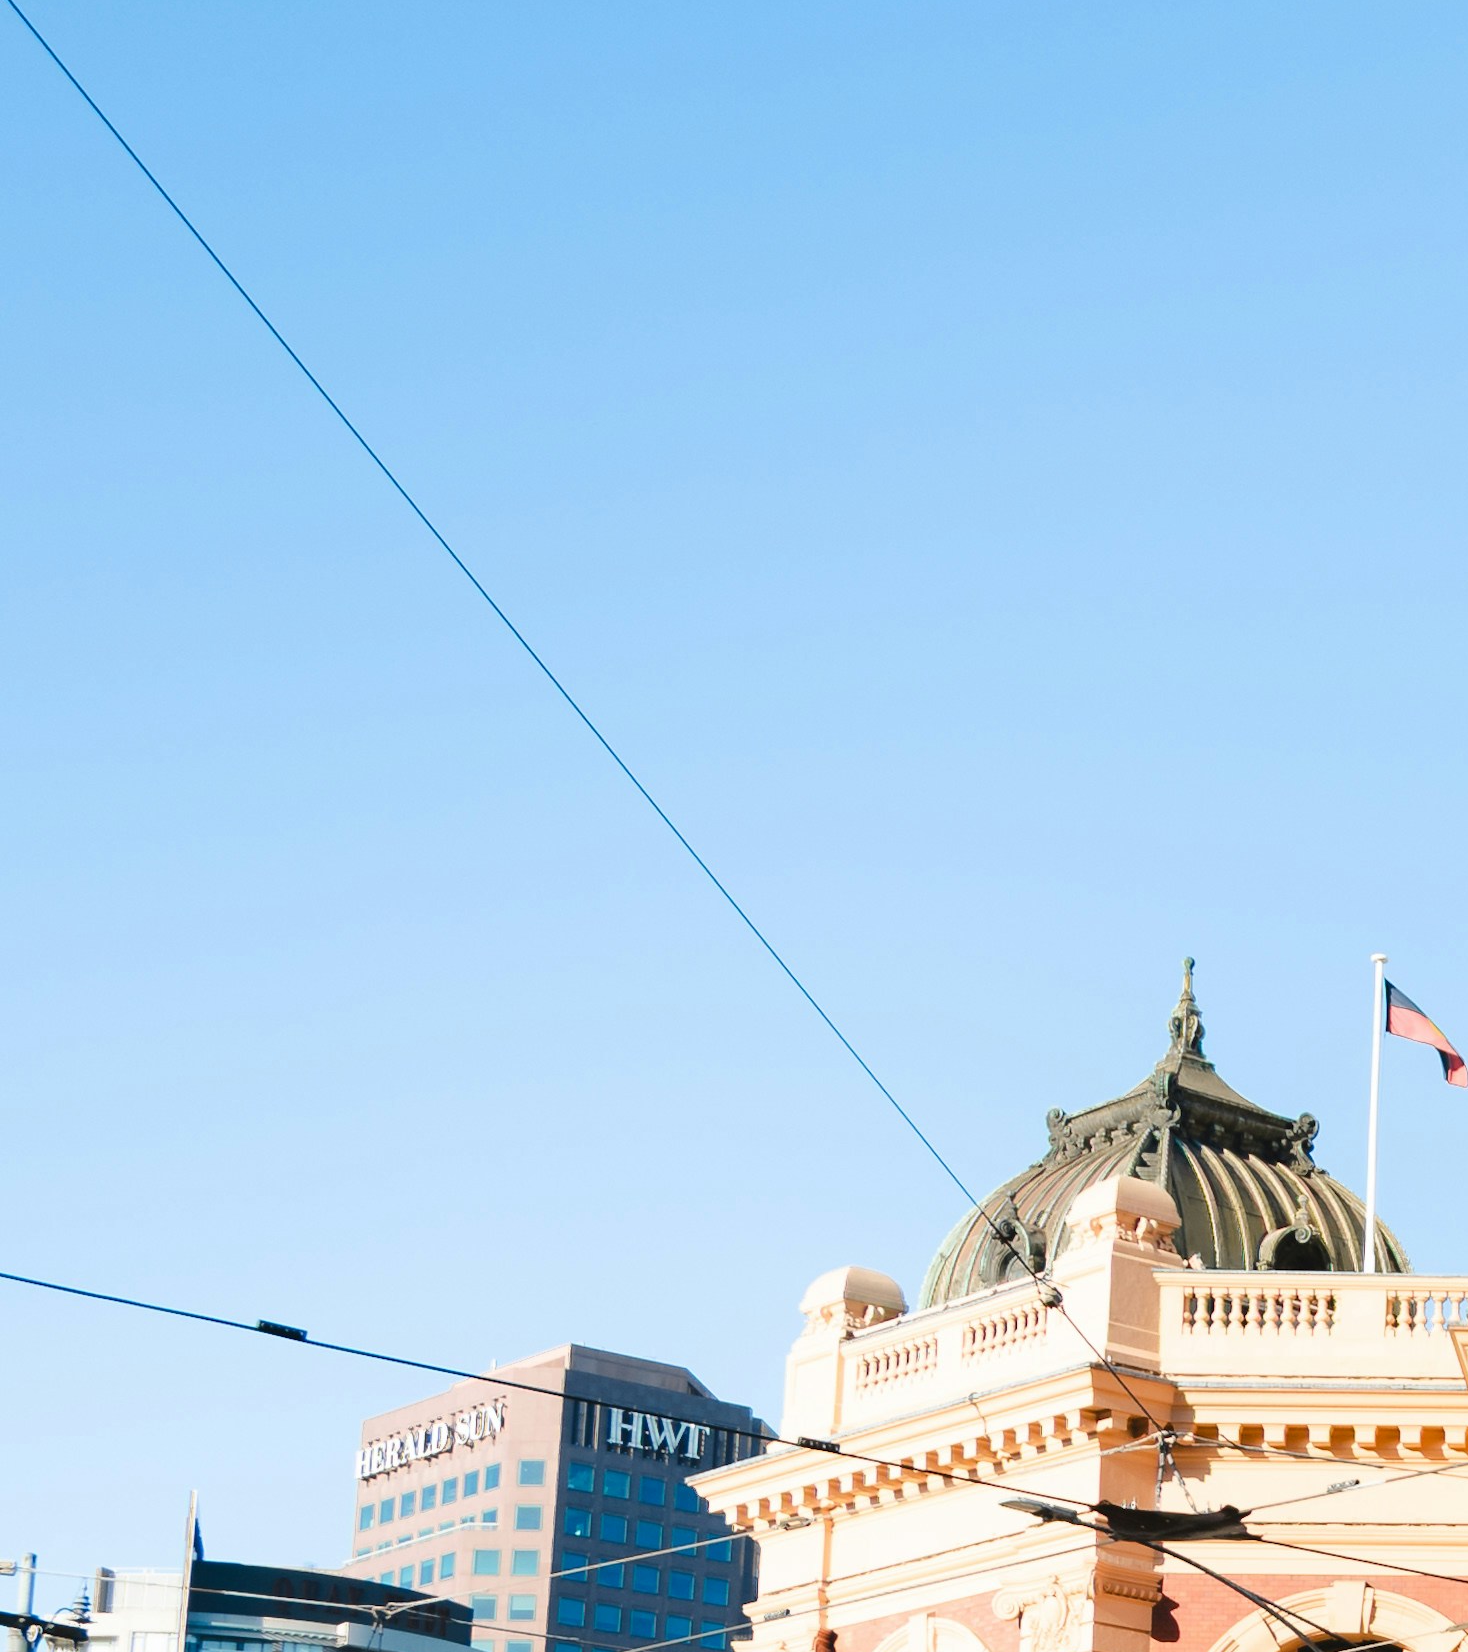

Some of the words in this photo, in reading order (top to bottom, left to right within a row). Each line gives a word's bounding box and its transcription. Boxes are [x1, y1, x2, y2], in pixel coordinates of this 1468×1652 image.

[355, 1421, 452, 1480] HERALD
[453, 1403, 506, 1445] SUN
[608, 1407, 711, 1460] HWT
